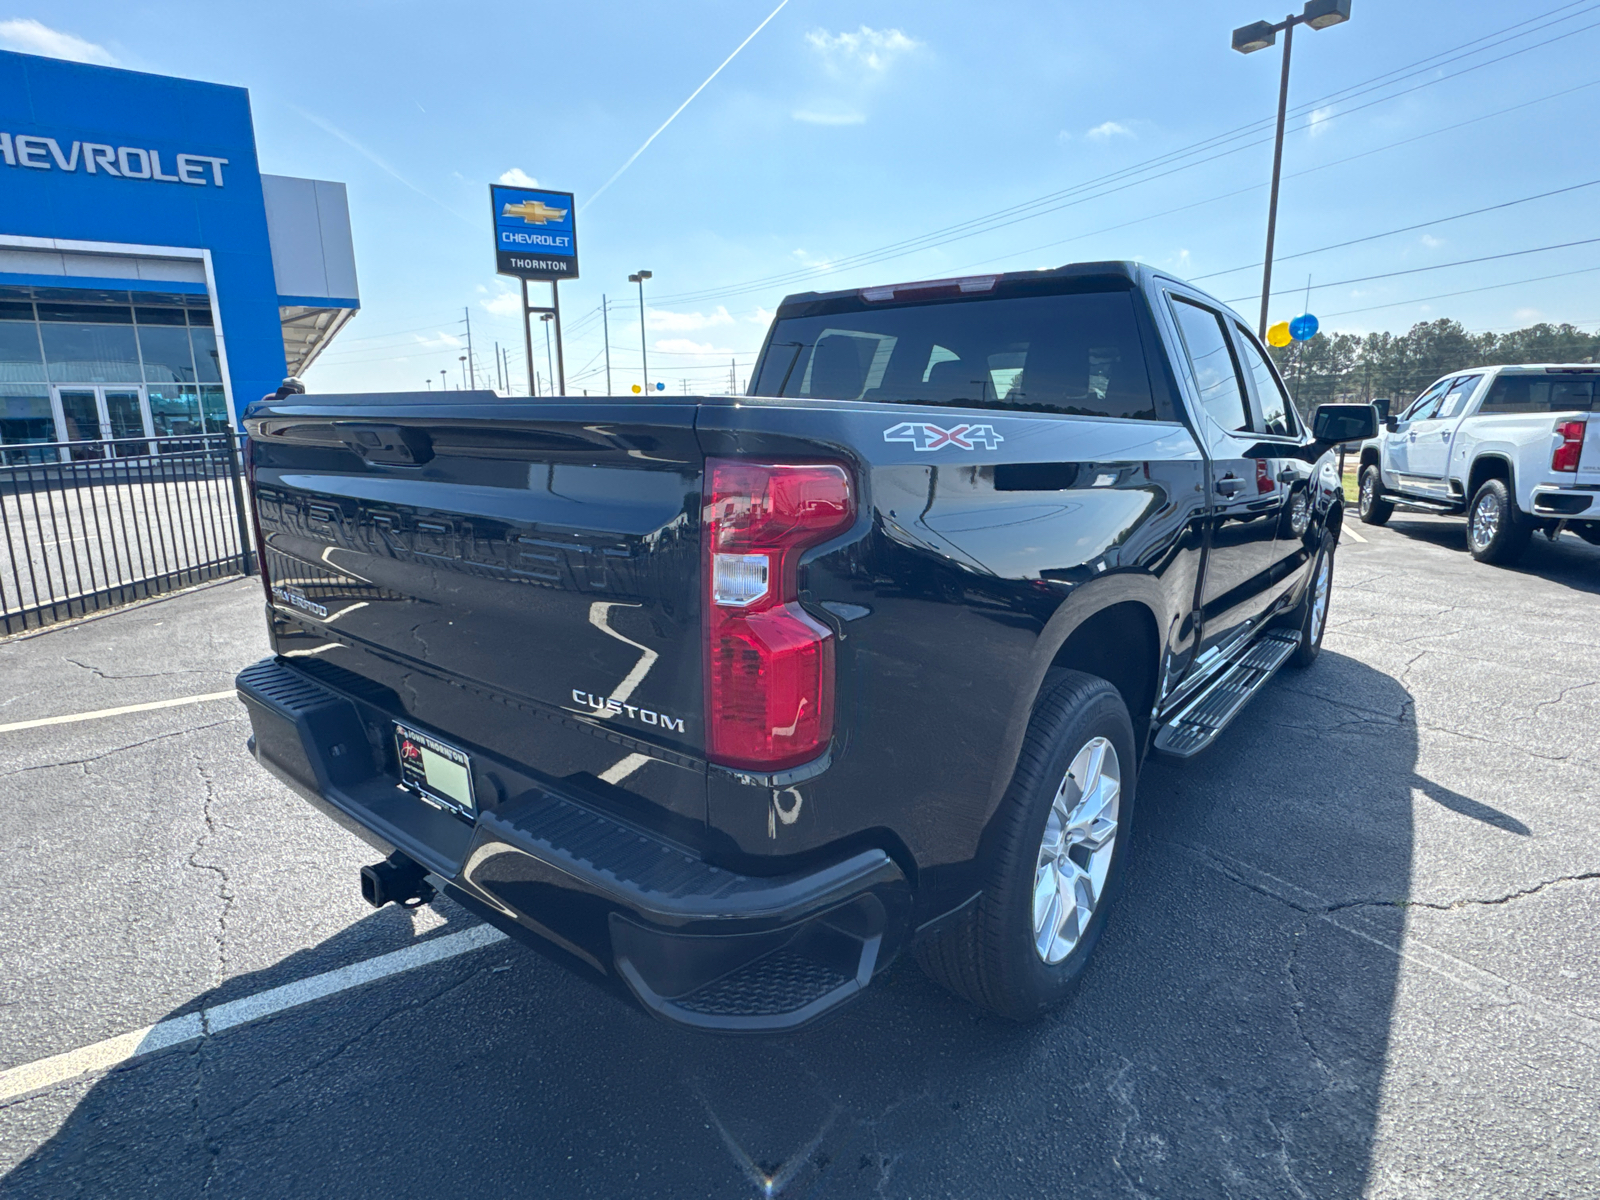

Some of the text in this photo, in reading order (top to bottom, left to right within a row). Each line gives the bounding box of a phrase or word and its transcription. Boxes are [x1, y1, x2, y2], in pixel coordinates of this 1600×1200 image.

[502, 232, 569, 247] CHEVROLET
[510, 258, 567, 271] THORNTON
[883, 422, 1004, 451] 4X4
[572, 689, 685, 733] CUSTOM
[408, 730, 426, 745] JOHN
